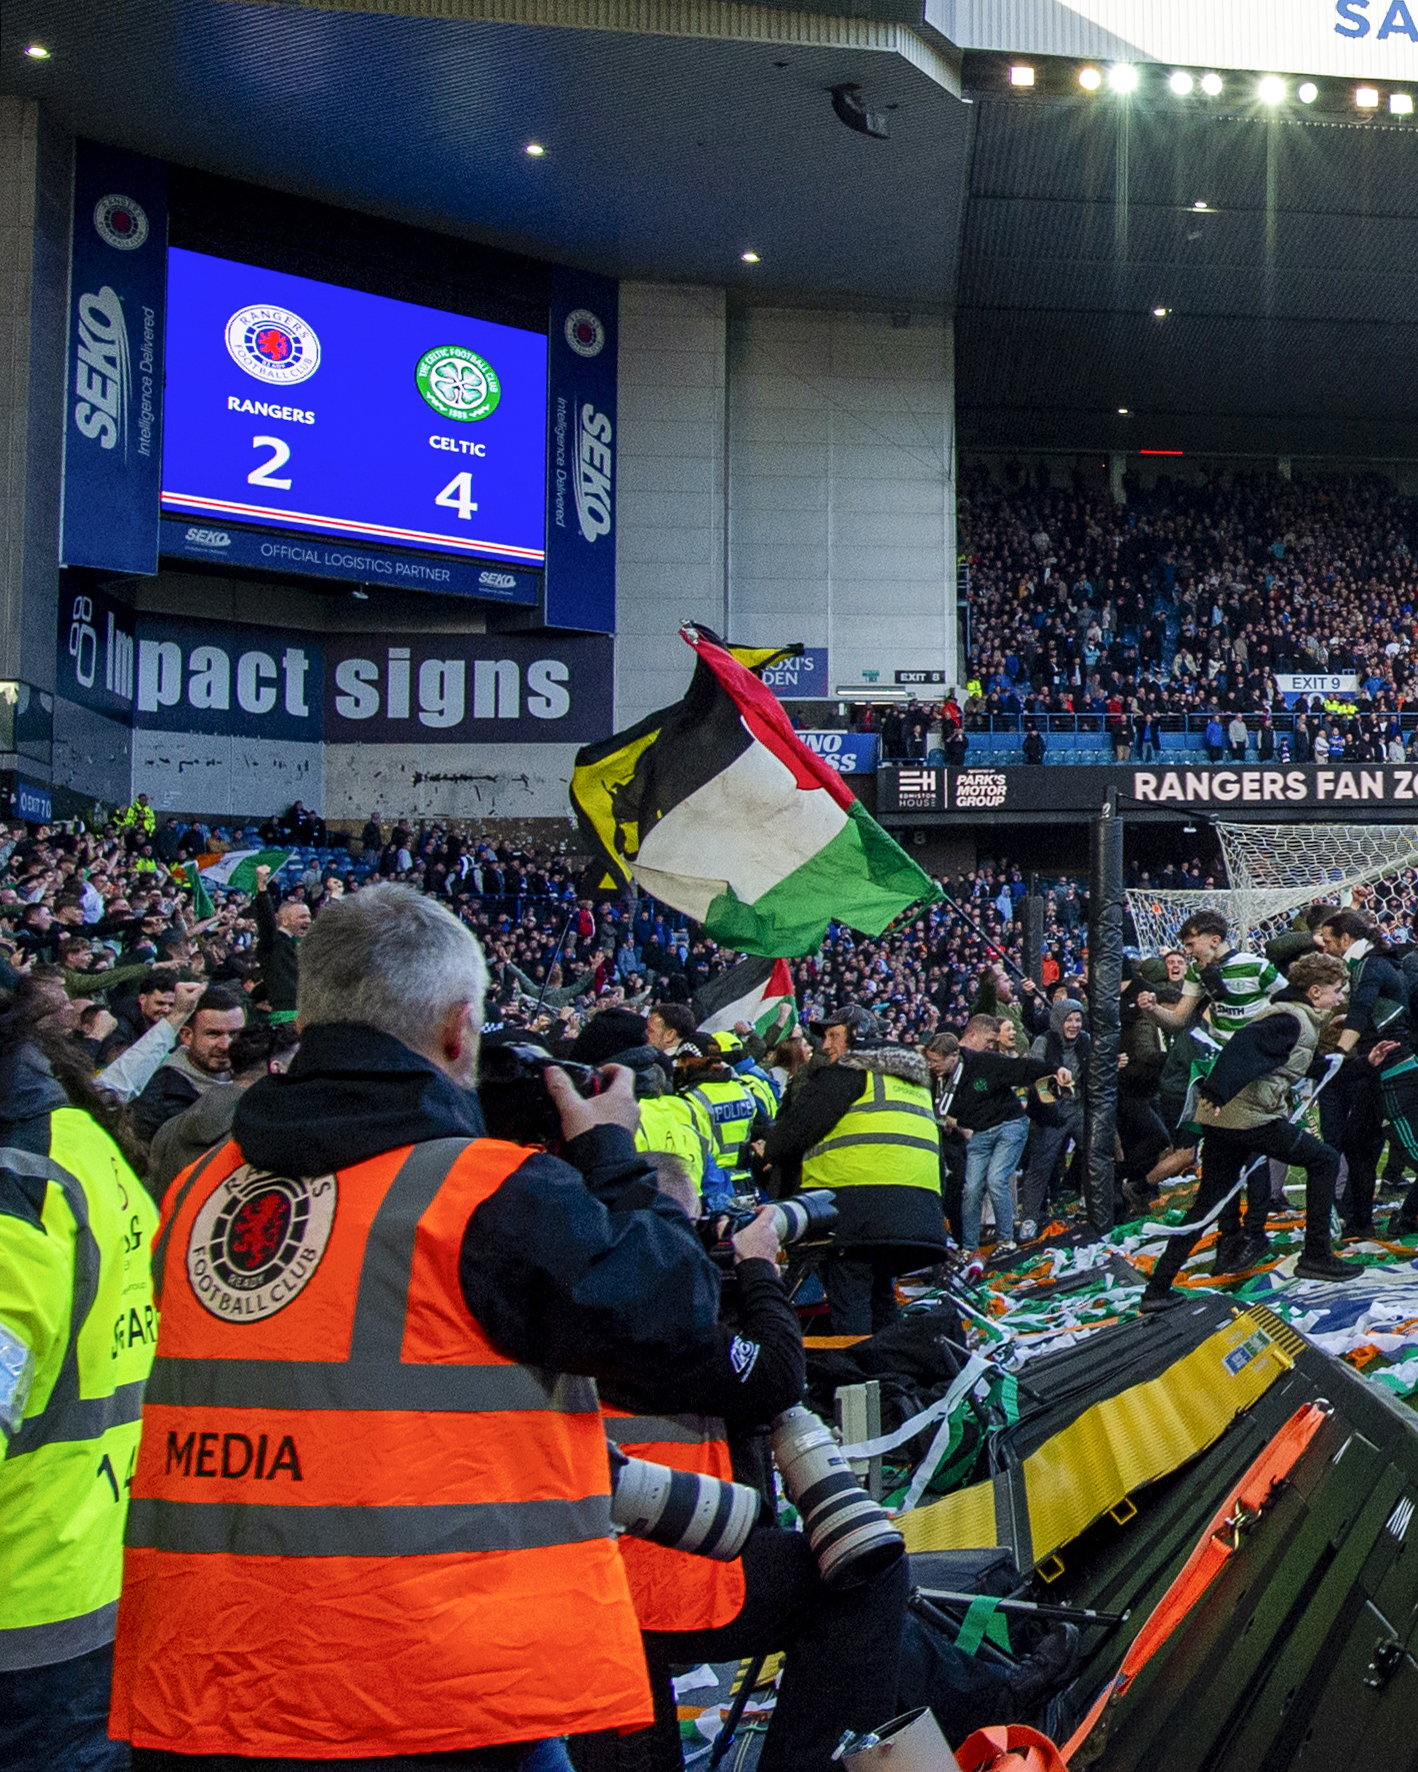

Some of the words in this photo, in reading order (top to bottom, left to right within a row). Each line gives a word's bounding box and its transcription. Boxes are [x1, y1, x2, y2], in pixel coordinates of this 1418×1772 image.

[139, 306, 155, 373] Delivered
[239, 310, 309, 339] RANGERS
[75, 285, 120, 450] SEKO
[137, 376, 155, 457] Intelligence
[227, 396, 315, 424] RANGERS
[429, 435, 486, 457] CELTIC
[554, 397, 568, 466] Intelligence
[247, 435, 292, 490] 2
[582, 403, 613, 543] SEKO
[435, 471, 478, 520] 4
[556, 468, 567, 527] Delivered
[185, 527, 231, 547] SEKO
[261, 543, 321, 564] OFFICIAL
[325, 552, 393, 575] LOGISTICS
[396, 563, 450, 582] PARTNER
[478, 571, 516, 588] SEKO
[106, 611, 309, 717] Impact
[762, 671, 798, 685] DEN
[900, 672, 927, 682] EXIT
[932, 672, 940, 682] 8
[335, 647, 570, 728] signs
[1292, 677, 1328, 690] EXIT
[1331, 677, 1341, 690] 9
[957, 774, 1006, 785] PARK'S
[957, 785, 1007, 796] MOTOR
[1135, 771, 1308, 801] RANGERS
[1316, 770, 1384, 800] FAN
[956, 796, 1005, 807] GROUP
[715, 1101, 753, 1121] POLICE
[192, 1245, 267, 1315] FOOTBALL
[270, 1247, 317, 1303] CLUB
[165, 1431, 303, 1482] MEDIA
